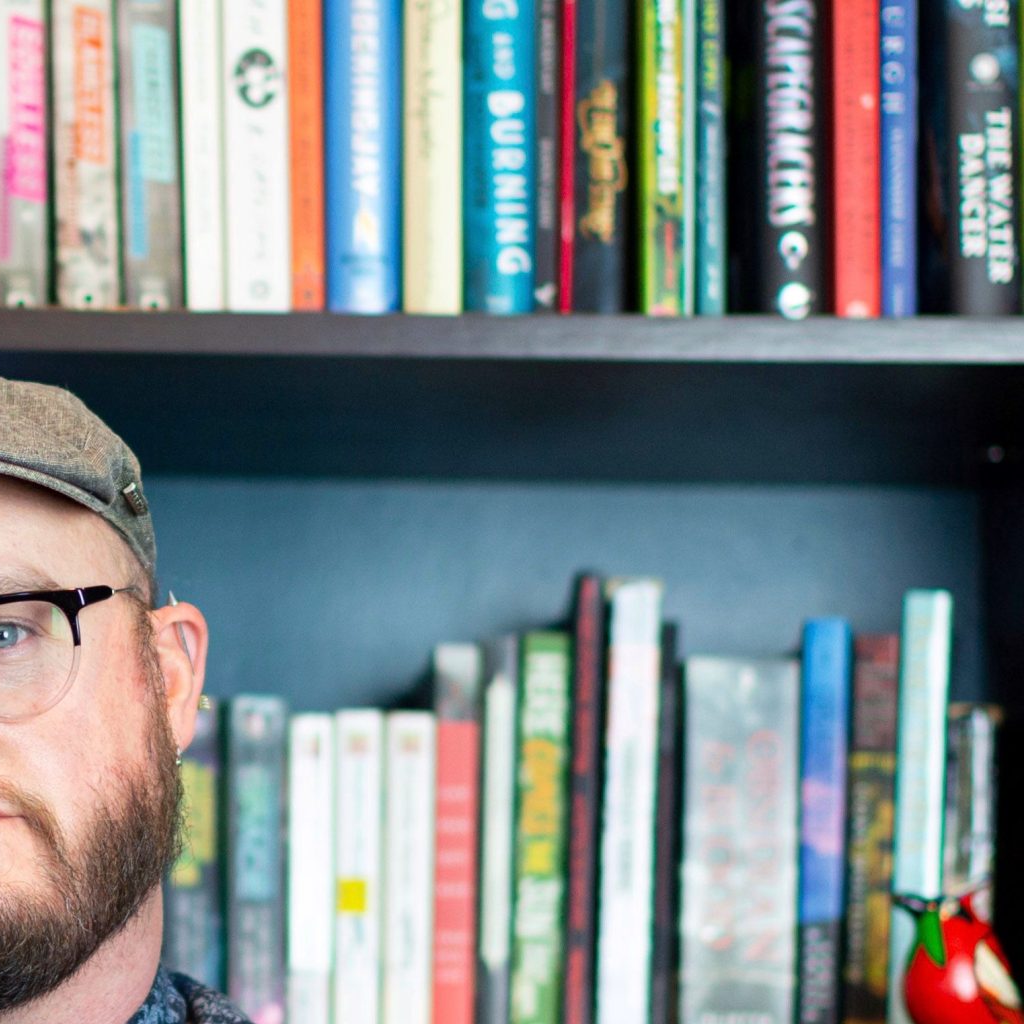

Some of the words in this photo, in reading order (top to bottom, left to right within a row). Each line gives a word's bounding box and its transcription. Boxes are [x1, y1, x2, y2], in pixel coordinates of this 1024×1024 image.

[487, 90, 532, 276] BURNING
[958, 133, 988, 259] DANCER
[984, 107, 1012, 169] THE
[986, 174, 1015, 283] WATER
